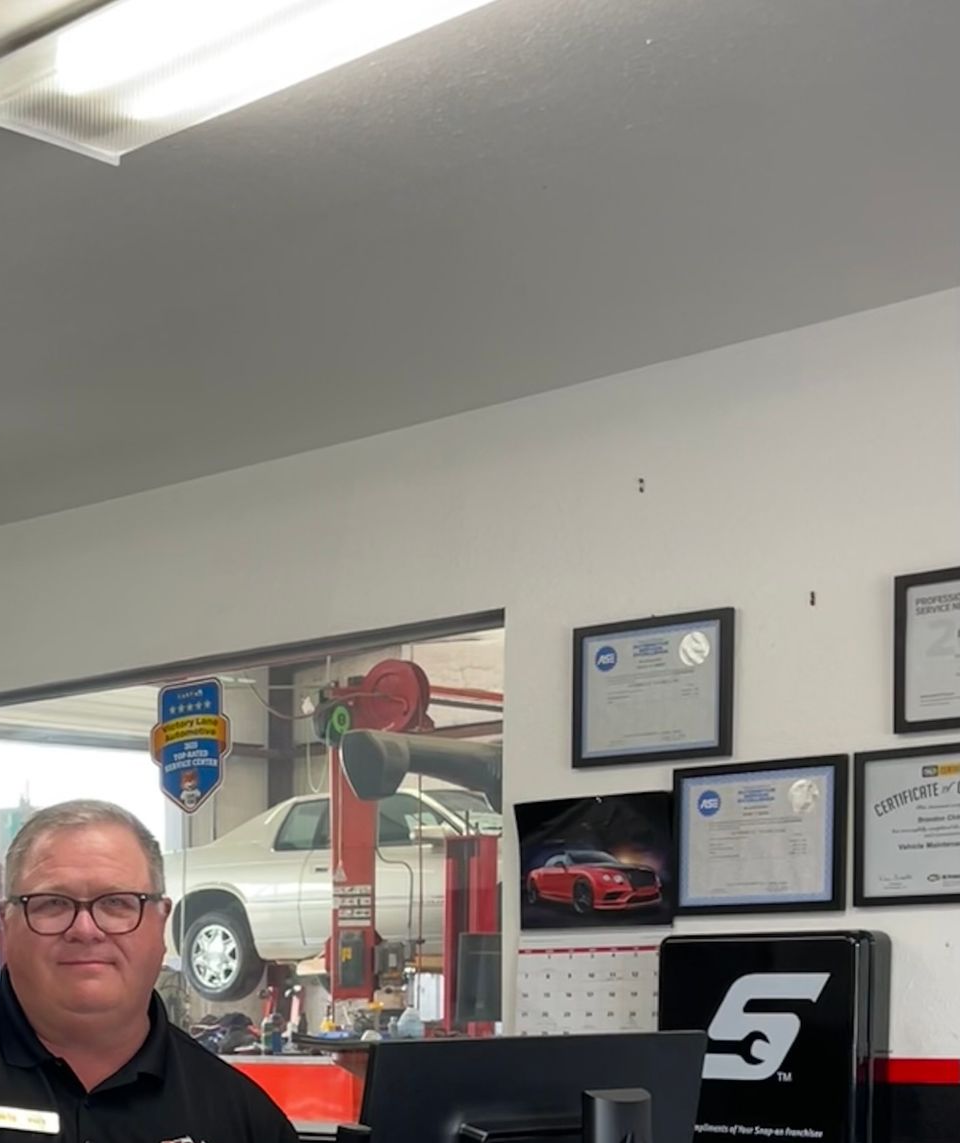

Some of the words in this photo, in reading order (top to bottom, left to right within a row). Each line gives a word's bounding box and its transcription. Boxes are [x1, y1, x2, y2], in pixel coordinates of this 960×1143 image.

[915, 603, 951, 616] SERVICE
[597, 653, 616, 666] ASE
[699, 798, 719, 809] ASE
[873, 782, 939, 817] CERTIFICATE
[776, 1071, 793, 1083] TM
[738, 1124, 754, 1135] Your
[754, 1125, 784, 1138] Snap-on
